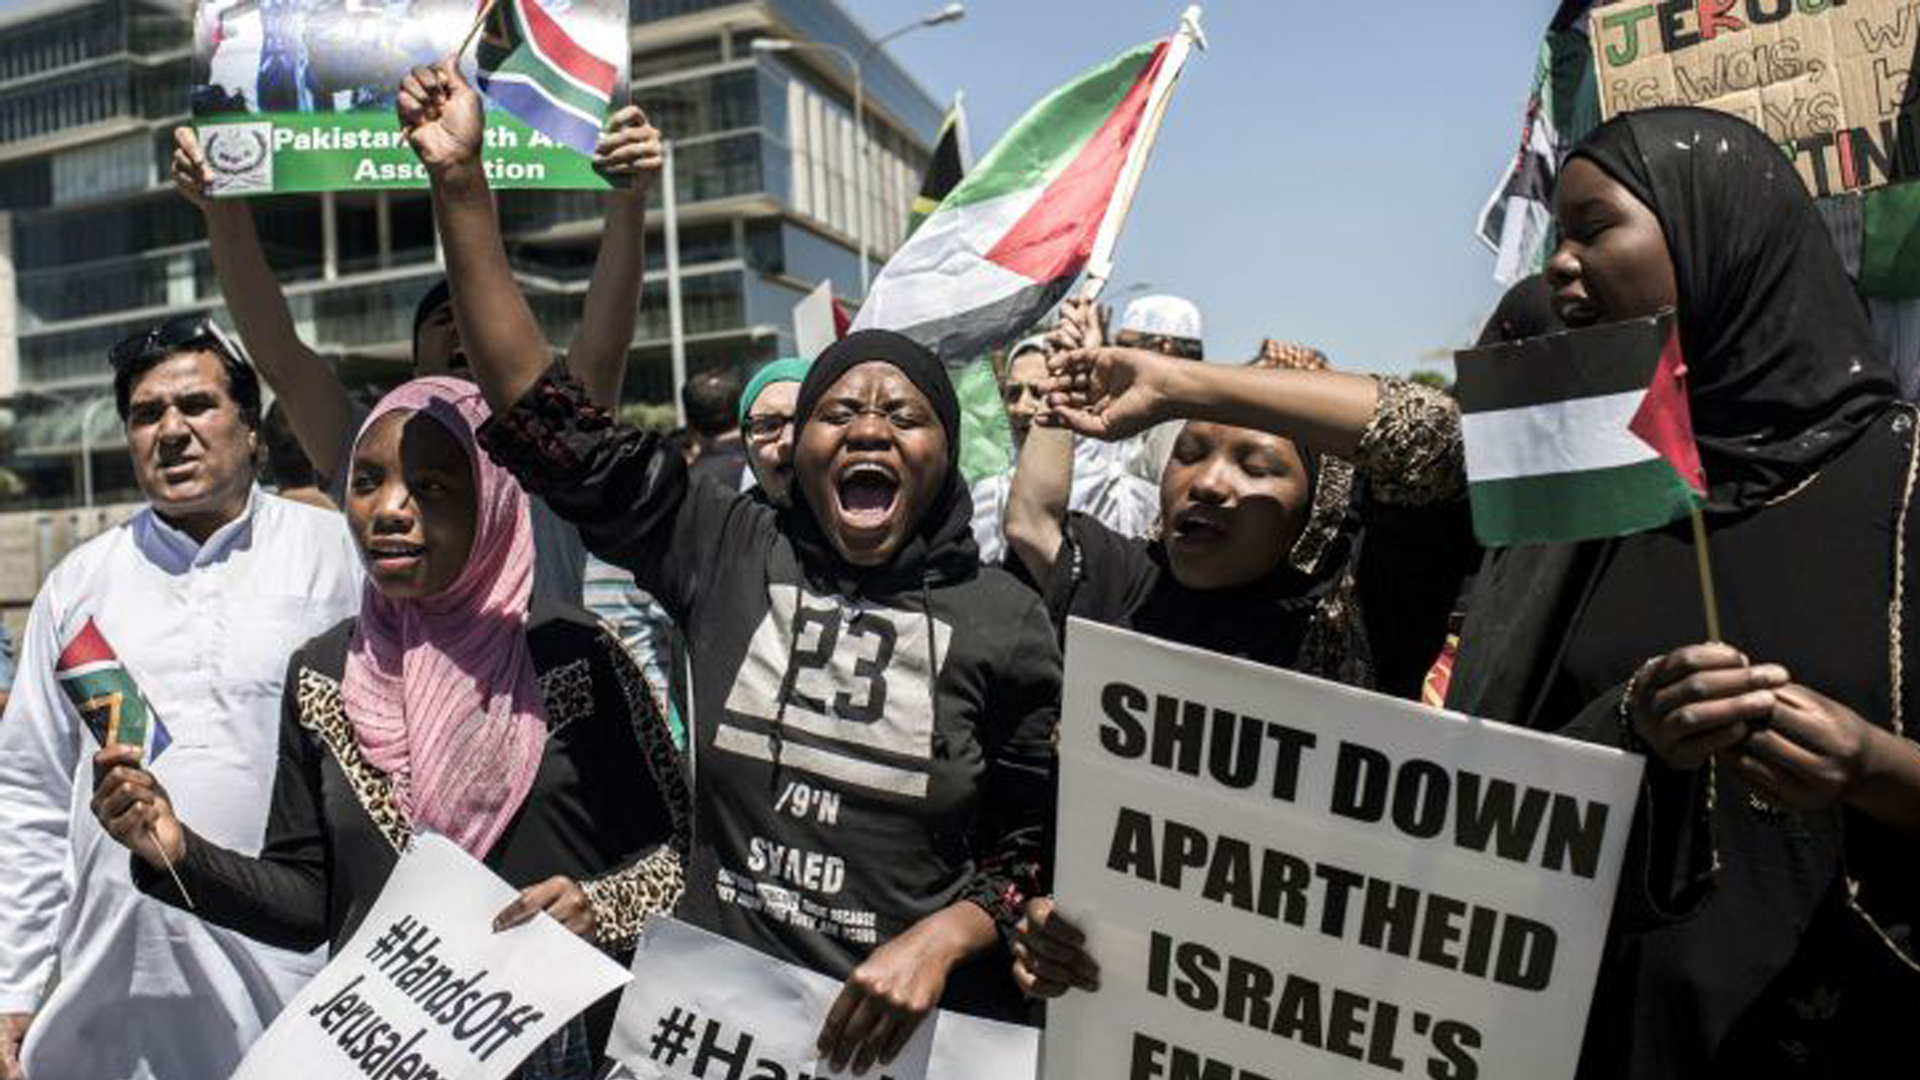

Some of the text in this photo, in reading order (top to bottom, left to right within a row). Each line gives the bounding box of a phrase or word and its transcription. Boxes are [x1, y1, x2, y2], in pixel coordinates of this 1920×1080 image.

[274, 127, 409, 151] Pakistan
[788, 605, 897, 724] 23
[1099, 682, 1609, 879] SHUT DOWN
[1106, 807, 1558, 993] APARTHEID
[365, 915, 545, 1062] #HandsOff
[1147, 931, 1483, 1080] ISRAEL'S
